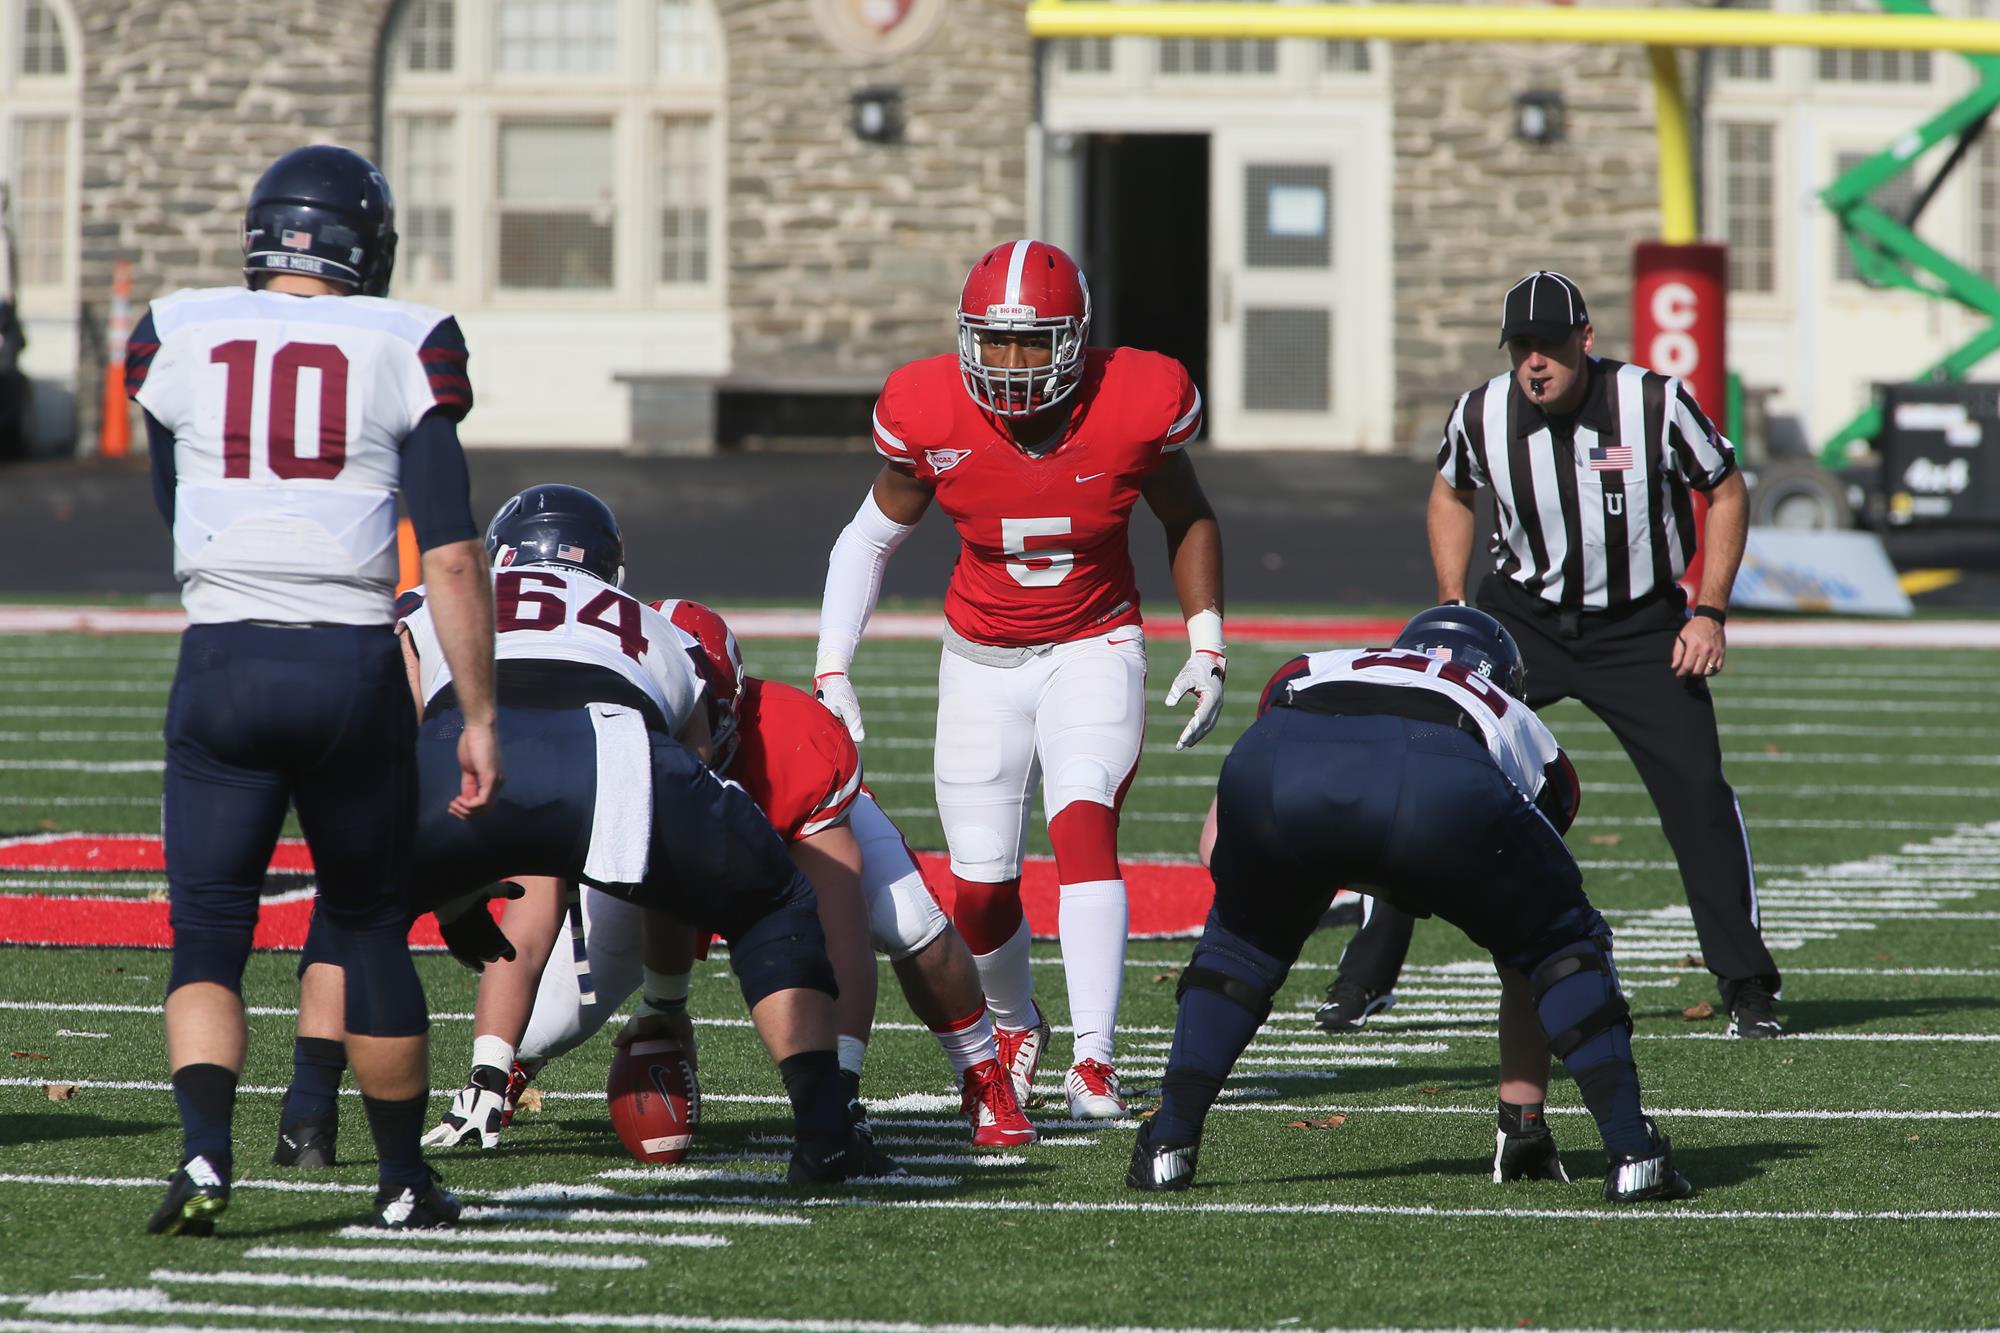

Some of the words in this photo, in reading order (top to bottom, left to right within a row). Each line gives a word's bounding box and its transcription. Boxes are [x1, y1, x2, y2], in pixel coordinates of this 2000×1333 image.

[266, 255, 287, 268] ONE
[210, 338, 349, 480] 10
[1605, 493, 1623, 515] U
[1001, 516, 1074, 587] 5
[496, 570, 650, 666] 64
[1477, 659, 1493, 678] 56
